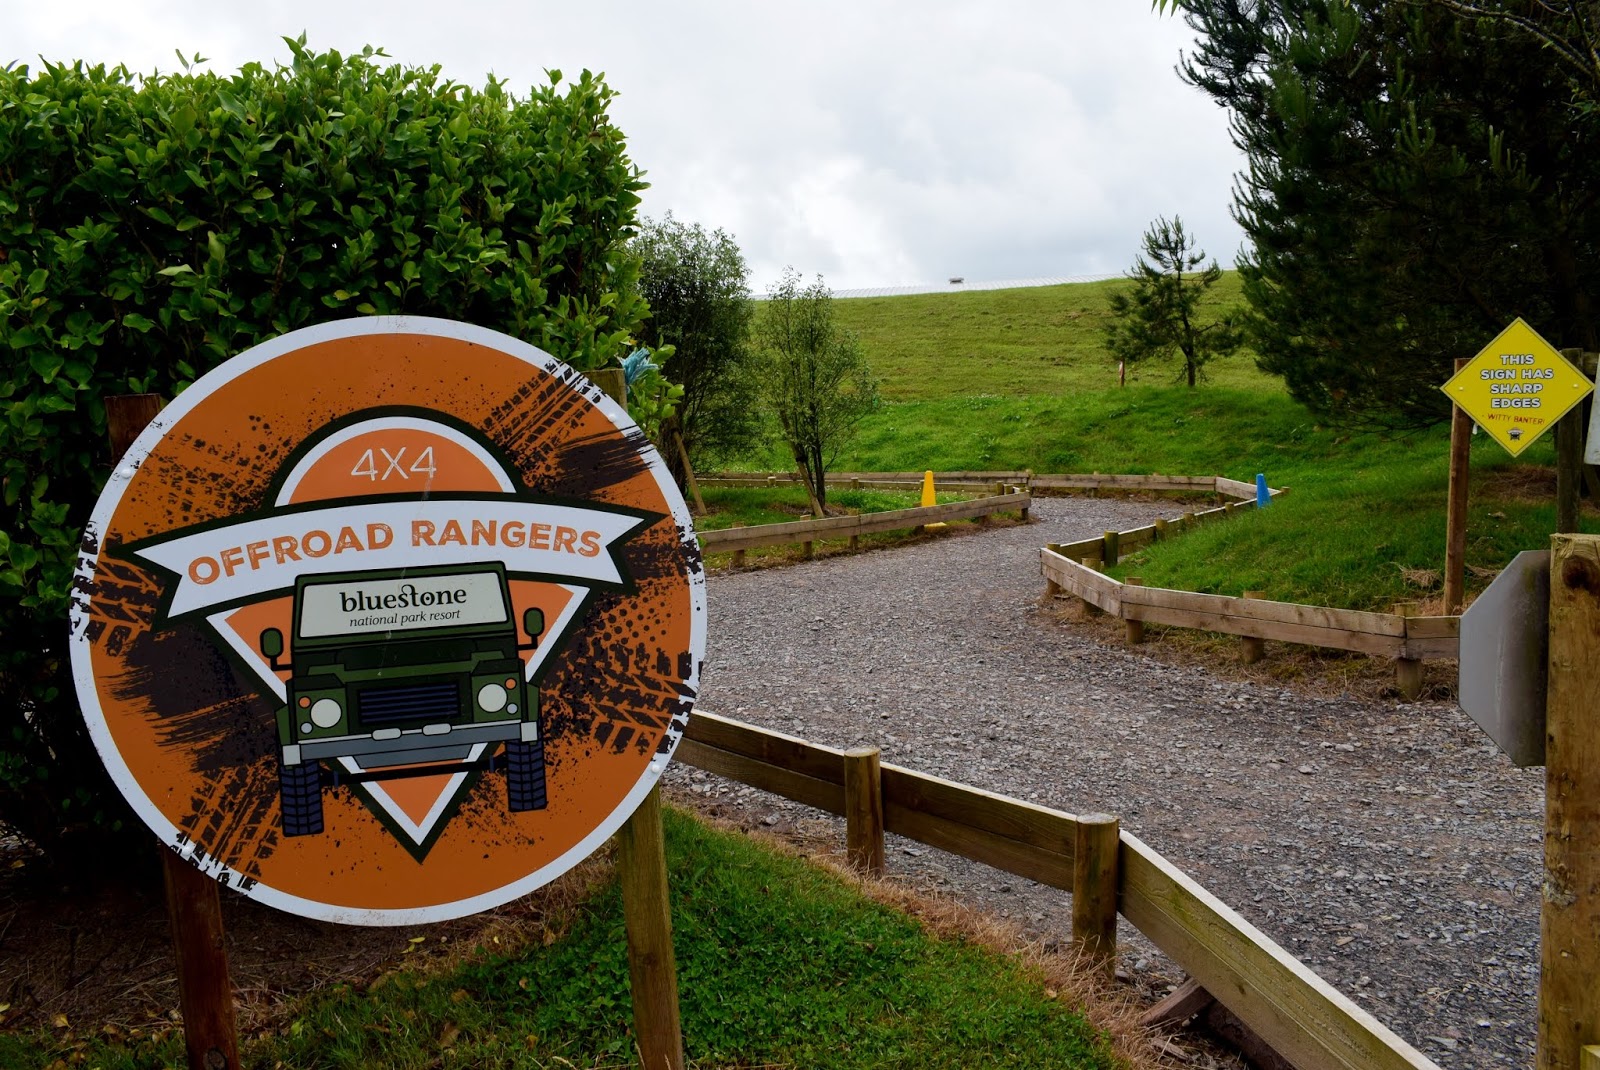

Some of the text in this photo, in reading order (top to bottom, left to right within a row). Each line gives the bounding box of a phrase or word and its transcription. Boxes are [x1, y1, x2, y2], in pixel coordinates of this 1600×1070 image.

[1500, 354, 1535, 365] THIS
[1480, 368, 1554, 380] SIGN HAS
[1490, 383, 1543, 394] SHARP
[1491, 398, 1541, 408] EDGES
[1487, 413, 1511, 421] WITTY
[350, 446, 437, 481] 4X4
[187, 519, 602, 586] OFFROAD RANGERS
[339, 583, 468, 613] bluestone
[349, 608, 462, 628] national park resort
